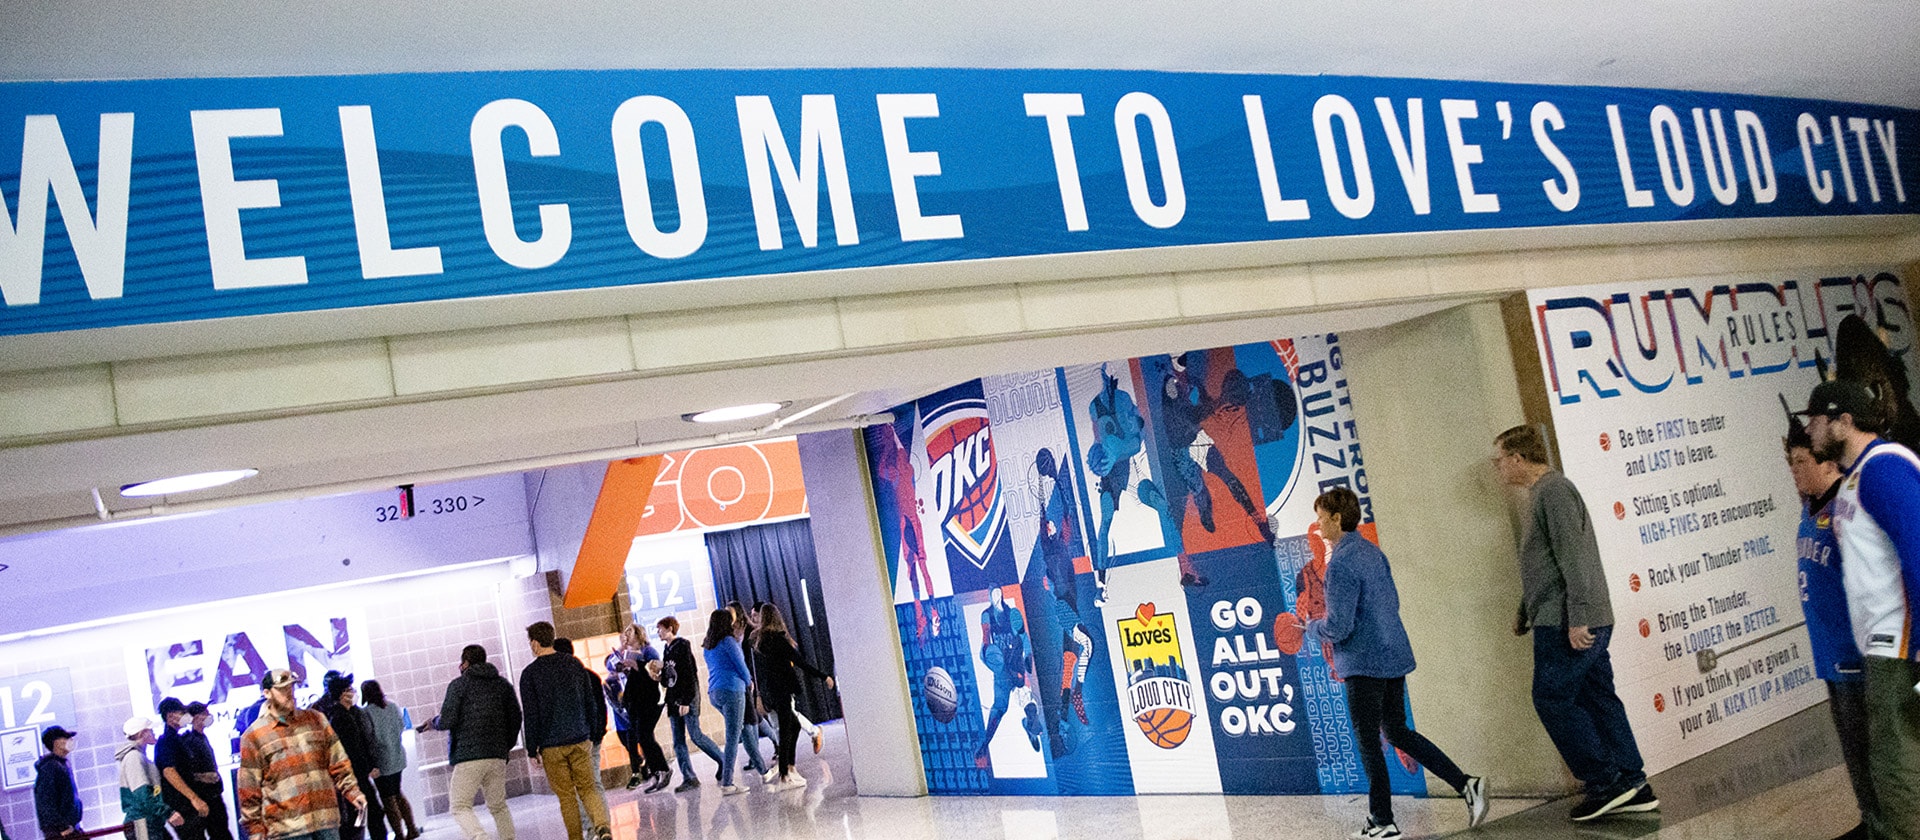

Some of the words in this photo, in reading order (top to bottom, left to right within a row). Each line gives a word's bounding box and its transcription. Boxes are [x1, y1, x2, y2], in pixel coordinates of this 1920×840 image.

[0, 93, 964, 305] WELCOME
[1023, 92, 1186, 231] TO
[1242, 93, 1579, 222] LOVE'S
[1606, 104, 1777, 208] LOUD
[1798, 112, 1906, 203] CITY
[1726, 310, 1797, 347] RULES
[1619, 429, 1634, 448] Be
[1636, 426, 1654, 445] the
[1656, 418, 1685, 441] FIRST
[1687, 418, 1698, 435] to
[1700, 414, 1725, 433] enter
[1344, 419, 1376, 524] FROM
[1625, 455, 1646, 477] and
[1648, 449, 1672, 472] LAST
[1674, 448, 1685, 466] to
[1687, 445, 1717, 463] leave.
[432, 496, 467, 514] 330
[1633, 493, 1670, 516] Sitting
[1669, 490, 1680, 508] is
[1639, 512, 1700, 545] HIGH-FIVES
[1701, 513, 1718, 529] are
[1721, 494, 1777, 524] encouraged.
[1648, 563, 1676, 588] Rock
[1678, 559, 1700, 583] your
[1702, 546, 1741, 572] Thunder
[1743, 535, 1775, 560] PRIDE.
[626, 570, 683, 612] 312
[1210, 597, 1263, 630] GO
[1657, 610, 1689, 633] Bring
[1689, 603, 1707, 622] the
[1212, 632, 1280, 667] ALL
[1664, 641, 1682, 661] the
[1684, 624, 1724, 654] LOUDER
[1725, 621, 1741, 640] the
[1743, 606, 1780, 634] BETTER.
[927, 676, 952, 698] Wilson
[1210, 667, 1293, 703] OUT,
[1672, 685, 1681, 706] If
[1685, 683, 1704, 706] you
[1705, 669, 1732, 694] think
[1734, 659, 1763, 687] you've
[1766, 648, 1790, 674] given
[1790, 643, 1799, 663] it
[1130, 680, 1162, 714] LOUD
[1162, 680, 1191, 709] CITY
[1679, 712, 1703, 739] your
[1705, 702, 1722, 725] all,
[1723, 691, 1748, 717] KICK
[1748, 686, 1758, 707] IT
[1759, 680, 1772, 702] UP
[1775, 678, 1782, 694] A
[1782, 664, 1814, 691] NOTCH.
[1221, 703, 1296, 737] OKC
[1300, 666, 1332, 786] THUNDER
[1314, 666, 1346, 786] THUNDER
